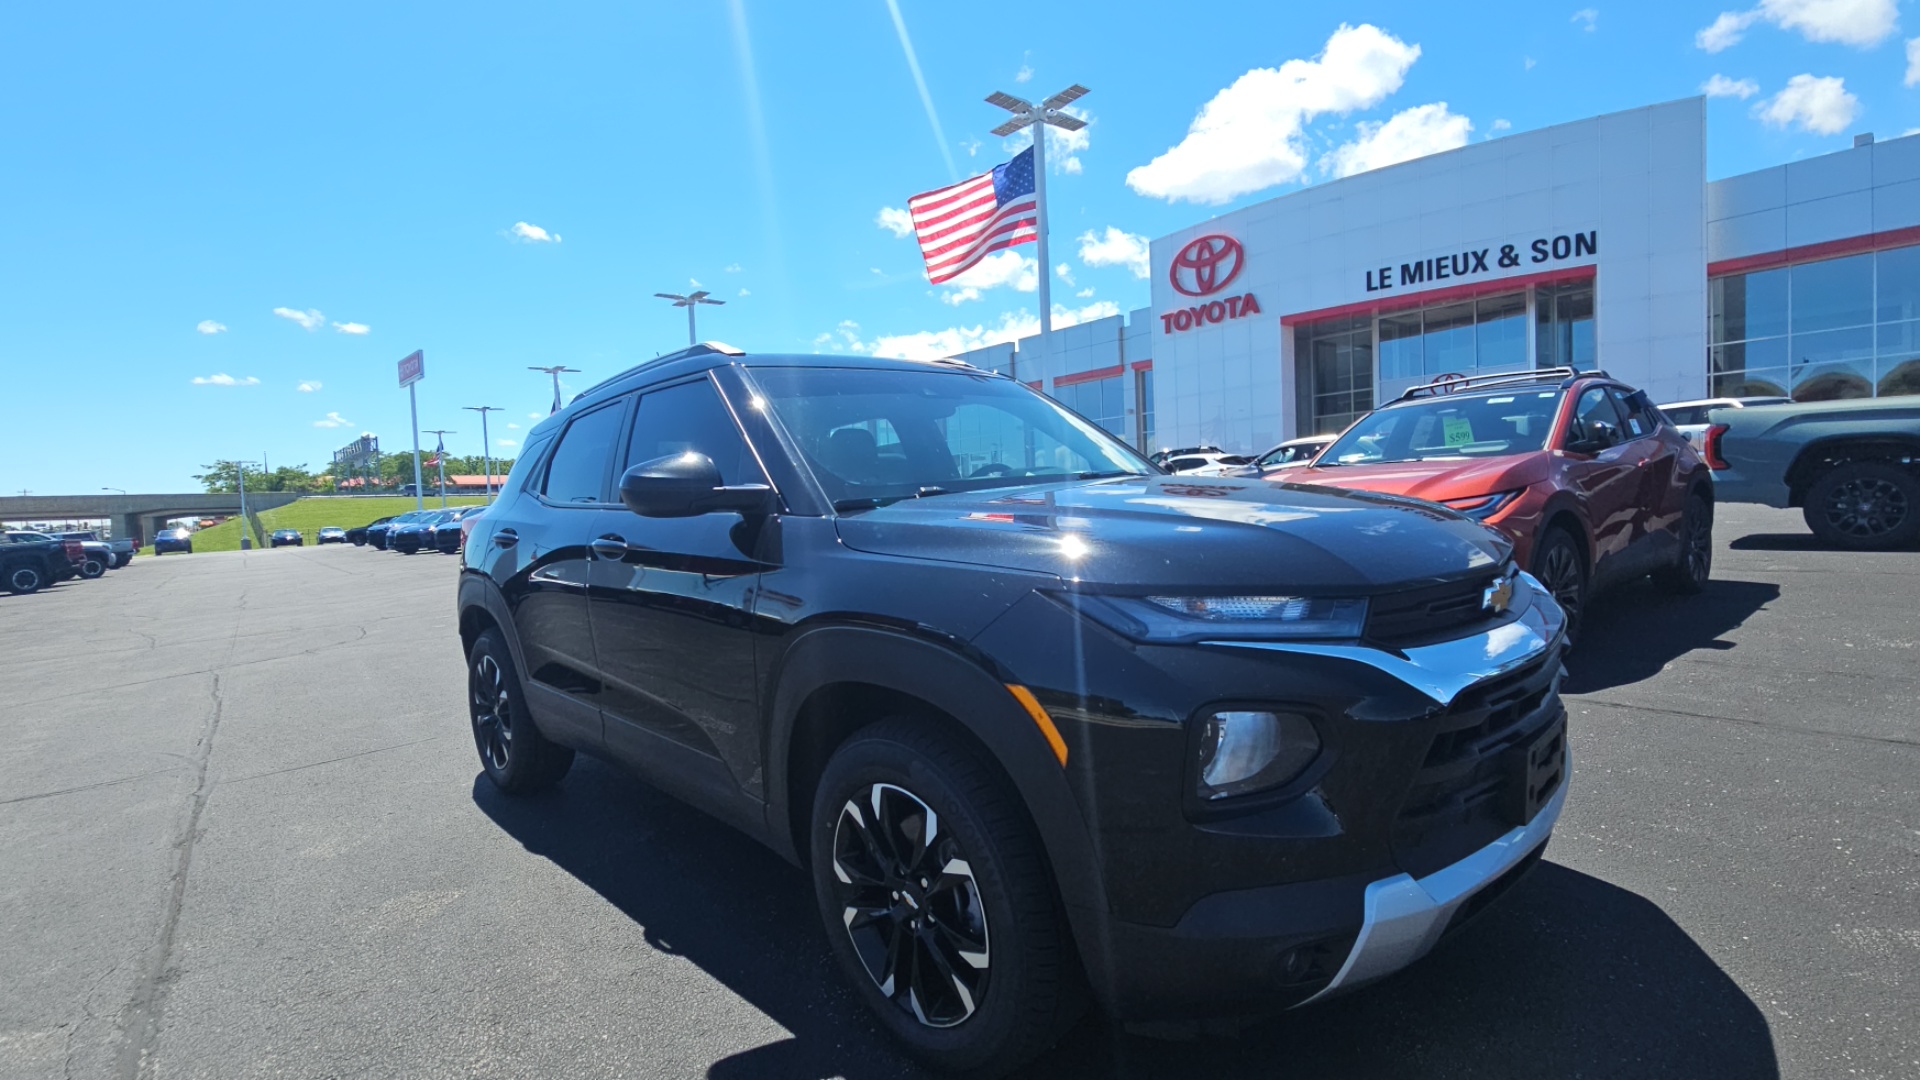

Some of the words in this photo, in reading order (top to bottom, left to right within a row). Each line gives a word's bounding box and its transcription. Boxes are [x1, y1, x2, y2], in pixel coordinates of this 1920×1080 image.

[1366, 267, 1392, 292] LE
[1401, 249, 1489, 286] MIEUX
[1497, 244, 1520, 268] &
[1531, 231, 1597, 263] SON
[1160, 293, 1260, 334] TOYOTA
[1449, 431, 1470, 443] $599
